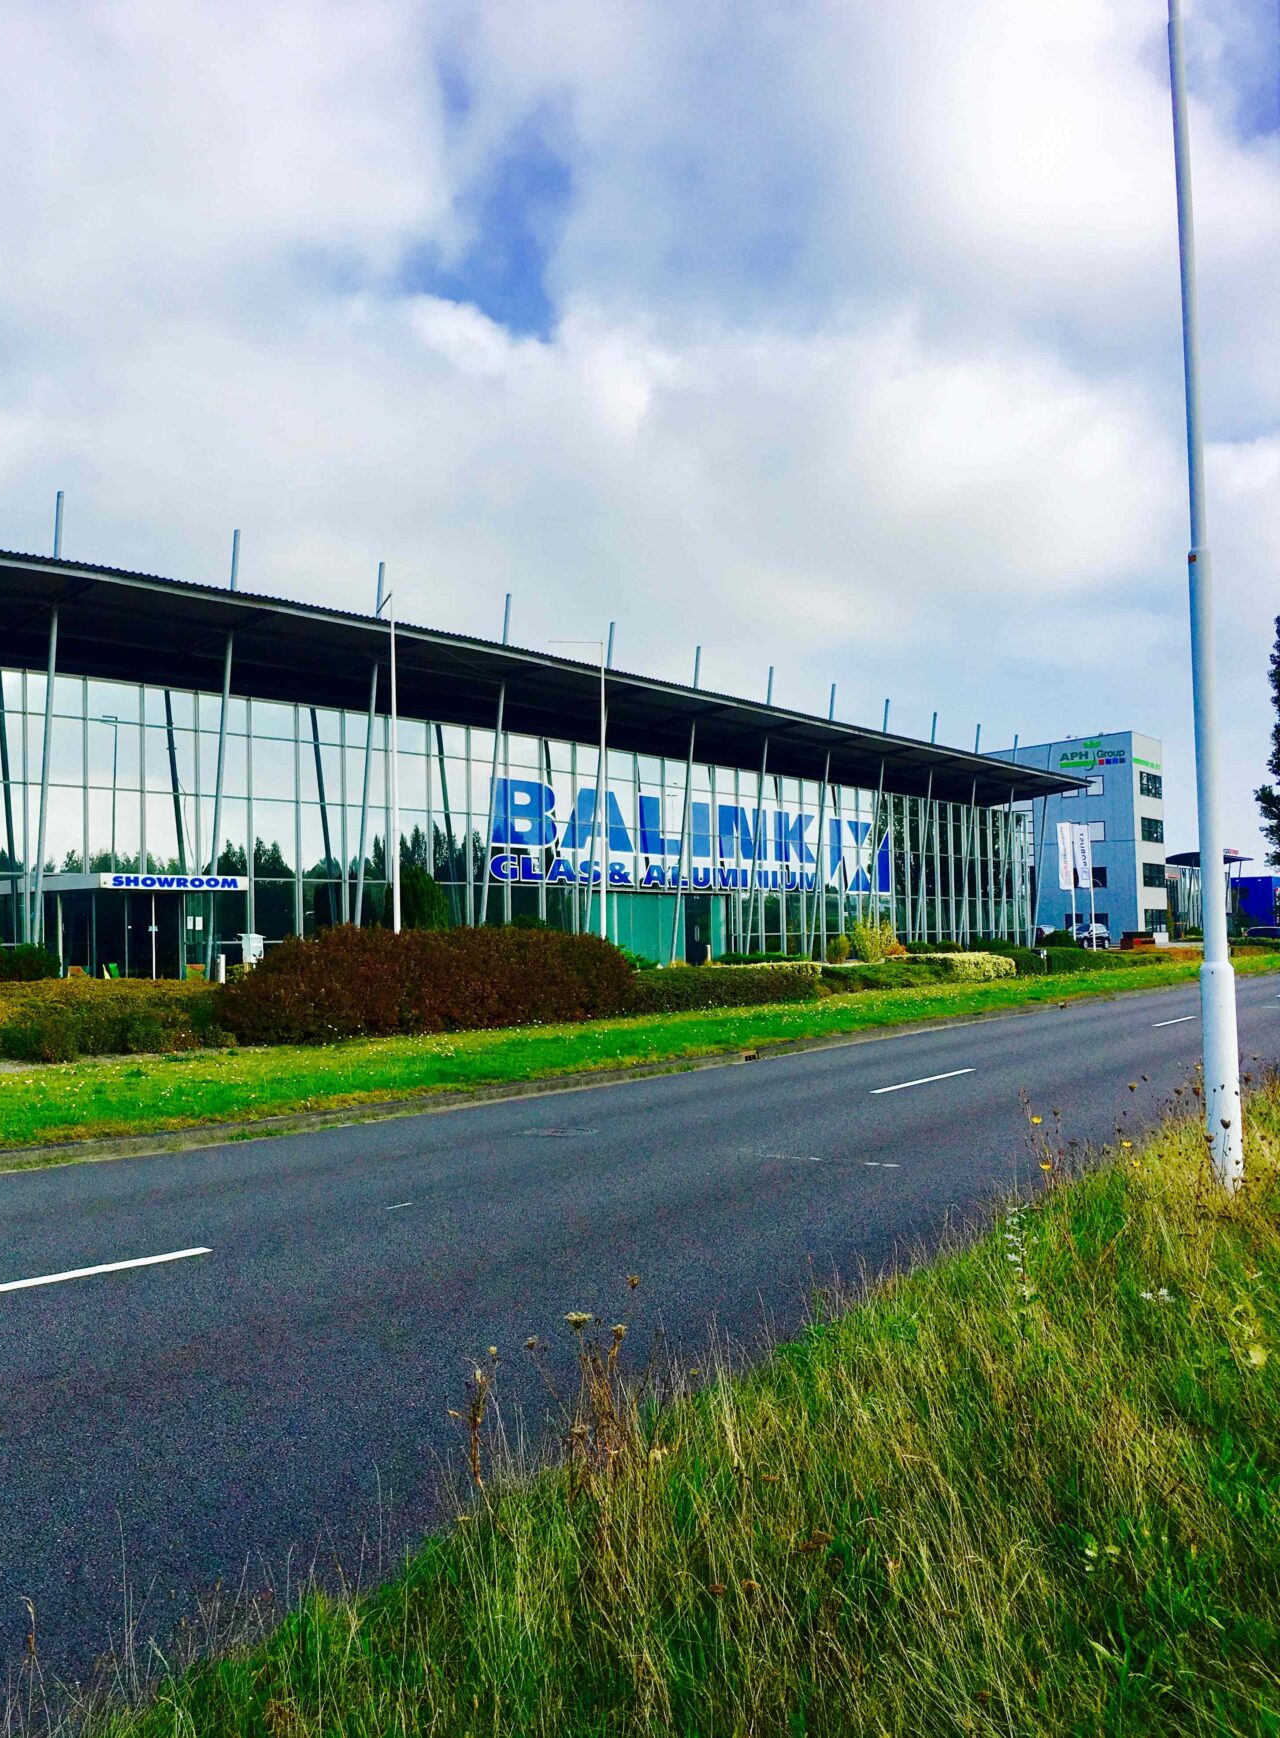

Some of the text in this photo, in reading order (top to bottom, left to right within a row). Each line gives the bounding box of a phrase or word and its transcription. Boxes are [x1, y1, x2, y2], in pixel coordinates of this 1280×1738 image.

[1060, 749, 1126, 761] APH Group
[112, 875, 239, 889] SHOWROOM
